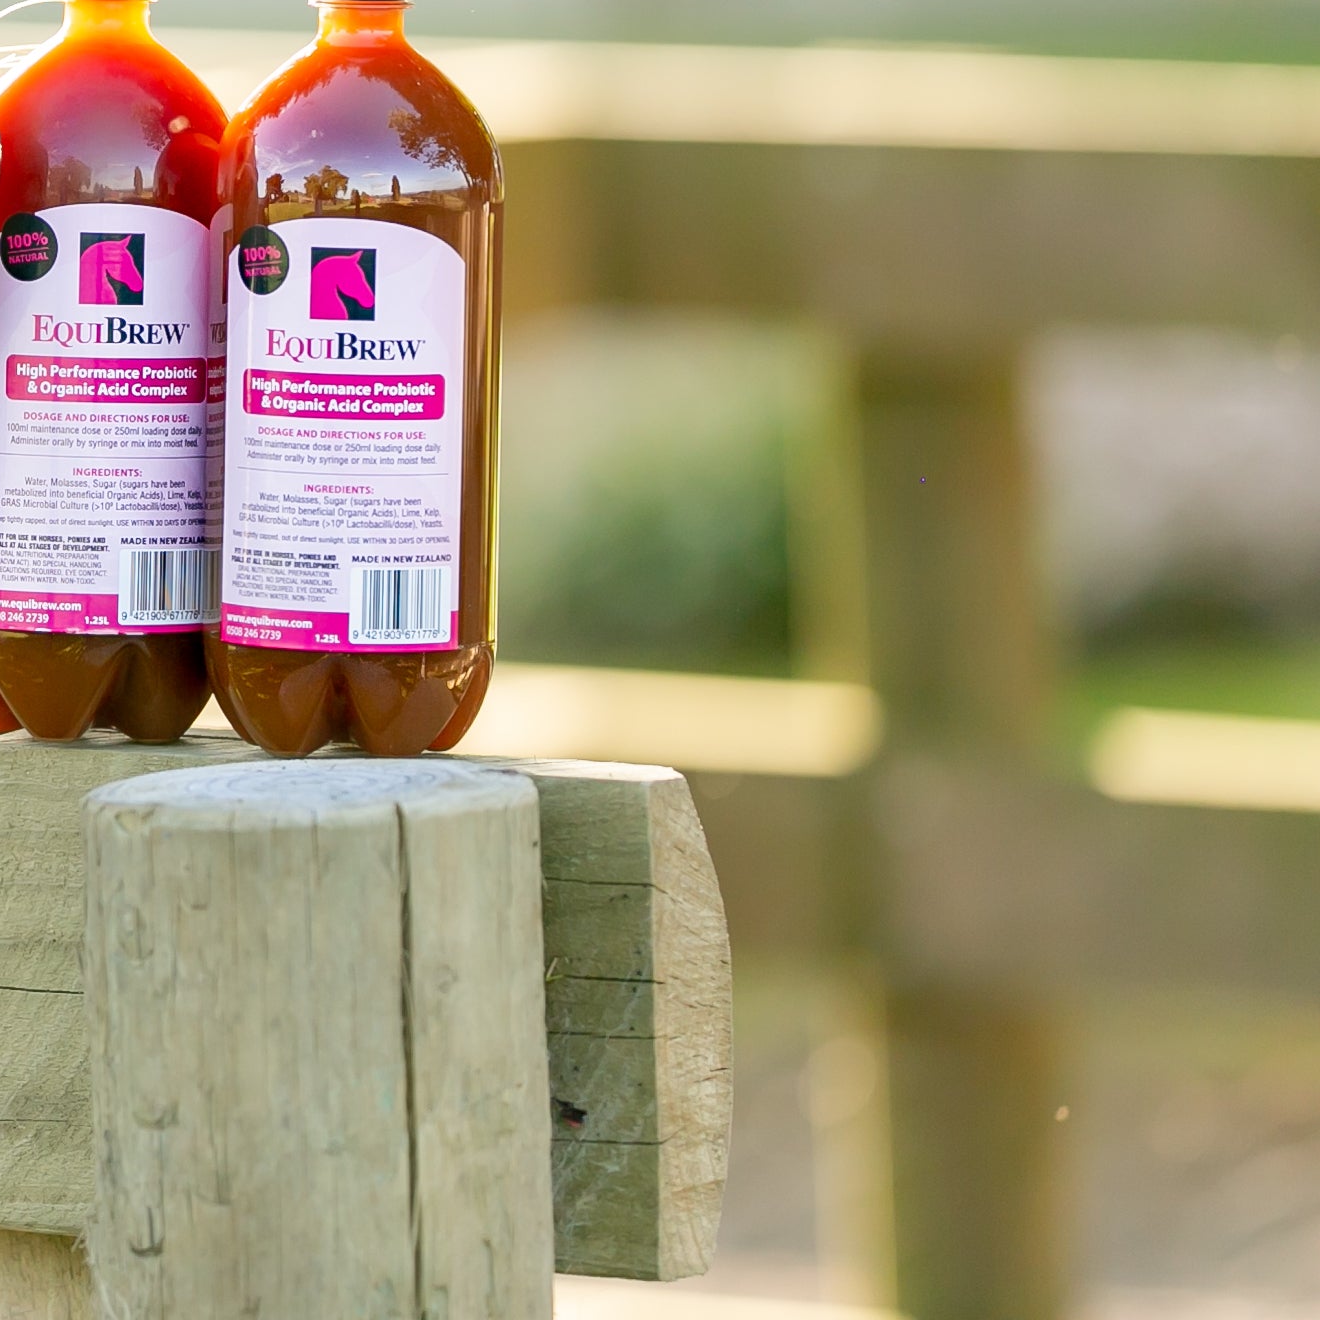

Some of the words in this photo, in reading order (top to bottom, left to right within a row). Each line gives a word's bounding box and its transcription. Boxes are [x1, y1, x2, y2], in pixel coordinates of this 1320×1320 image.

[16, 363, 47, 379] High
[50, 365, 140, 380] Performance
[142, 366, 197, 379] Probiotic
[27, 382, 38, 394] &
[40, 382, 94, 397] Organic
[97, 383, 128, 396] Acid
[133, 383, 187, 399] Complex
[252, 378, 279, 396] High
[282, 380, 371, 396] Performance
[374, 383, 435, 397] Probiotic
[261, 398, 271, 409] &
[273, 398, 325, 413] Organic
[328, 399, 359, 413] Acid
[362, 400, 423, 416] Complex
[24, 412, 62, 421] DOSAGE
[90, 414, 149, 423] DIRECTIONS
[152, 415, 170, 423] FOR
[172, 415, 189, 423] USE:
[7, 423, 28, 432] 100ml
[31, 424, 79, 434] maintenance
[82, 426, 101, 435] dose
[115, 426, 139, 436] 250ml
[142, 427, 168, 437] loading
[171, 427, 186, 436] dose
[258, 427, 293, 436] DOSAGE
[296, 430, 317, 438] AND
[320, 430, 381, 439] DIRECTIONS
[10, 436, 49, 446] Administer
[52, 438, 73, 448] orally
[77, 439, 86, 448] by
[89, 438, 118, 448] syringe
[131, 439, 145, 447] mix
[147, 439, 161, 447] into
[164, 438, 182, 447] moist
[73, 468, 142, 477] INGREDIENTS:
[50, 478, 90, 488] Molasses,
[93, 479, 116, 489] Sugar
[120, 480, 148, 489] (sugars
[151, 480, 168, 488] have
[170, 480, 185, 488] been
[304, 485, 374, 494] INGREDIENTS:
[120, 537, 147, 545] MADE
[149, 537, 158, 545] IN
[160, 537, 178, 545] NEW
[352, 555, 379, 563] MADE
[415, 555, 451, 563] ZEALAND
[8, 613, 24, 622] 246
[26, 614, 49, 623] 2739
[85, 616, 109, 625] 1.25L
[134, 612, 166, 621] 421903
[170, 612, 199, 620] 671776
[227, 613, 312, 629] www.equibrew.com
[227, 626, 242, 637] 0508
[244, 628, 259, 638] 246
[260, 629, 282, 641] 2739
[315, 634, 340, 644] 1.25L
[365, 631, 401, 639] 421903
[405, 630, 437, 638] 671776
